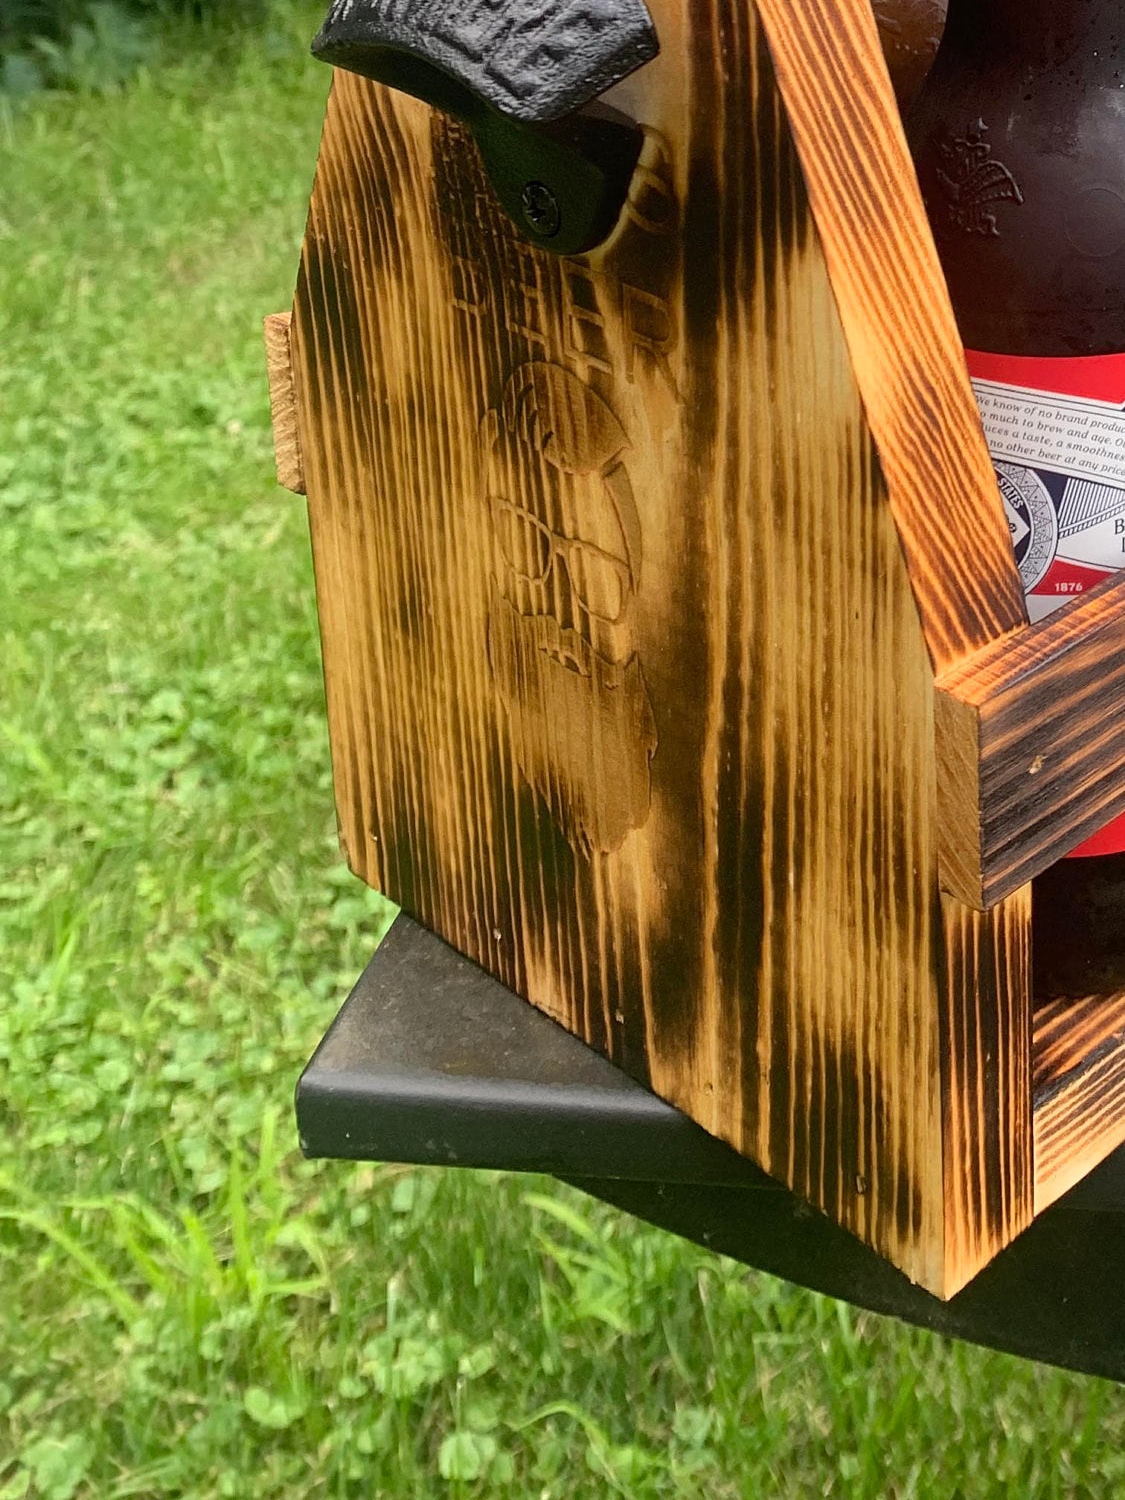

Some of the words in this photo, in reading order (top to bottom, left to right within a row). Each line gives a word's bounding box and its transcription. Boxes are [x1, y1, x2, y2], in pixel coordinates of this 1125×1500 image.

[993, 398, 1022, 413] know
[1024, 406, 1039, 417] of
[1039, 409, 1052, 419] no
[1054, 411, 1089, 426] brand
[989, 412, 1019, 425] much
[1022, 419, 1034, 429] to
[1037, 422, 1066, 435] brew
[1067, 426, 1089, 440] and
[1090, 434, 1113, 446] age.
[1022, 432, 1053, 447] taste,
[1056, 439, 1064, 448] a
[989, 440, 1004, 449] no
[1006, 443, 1036, 455] other
[1038, 449, 1063, 462] beer
[1064, 456, 1077, 464] at
[1078, 459, 1100, 471] any
[998, 474, 1025, 509] STATES
[1054, 582, 1083, 593] 1876
